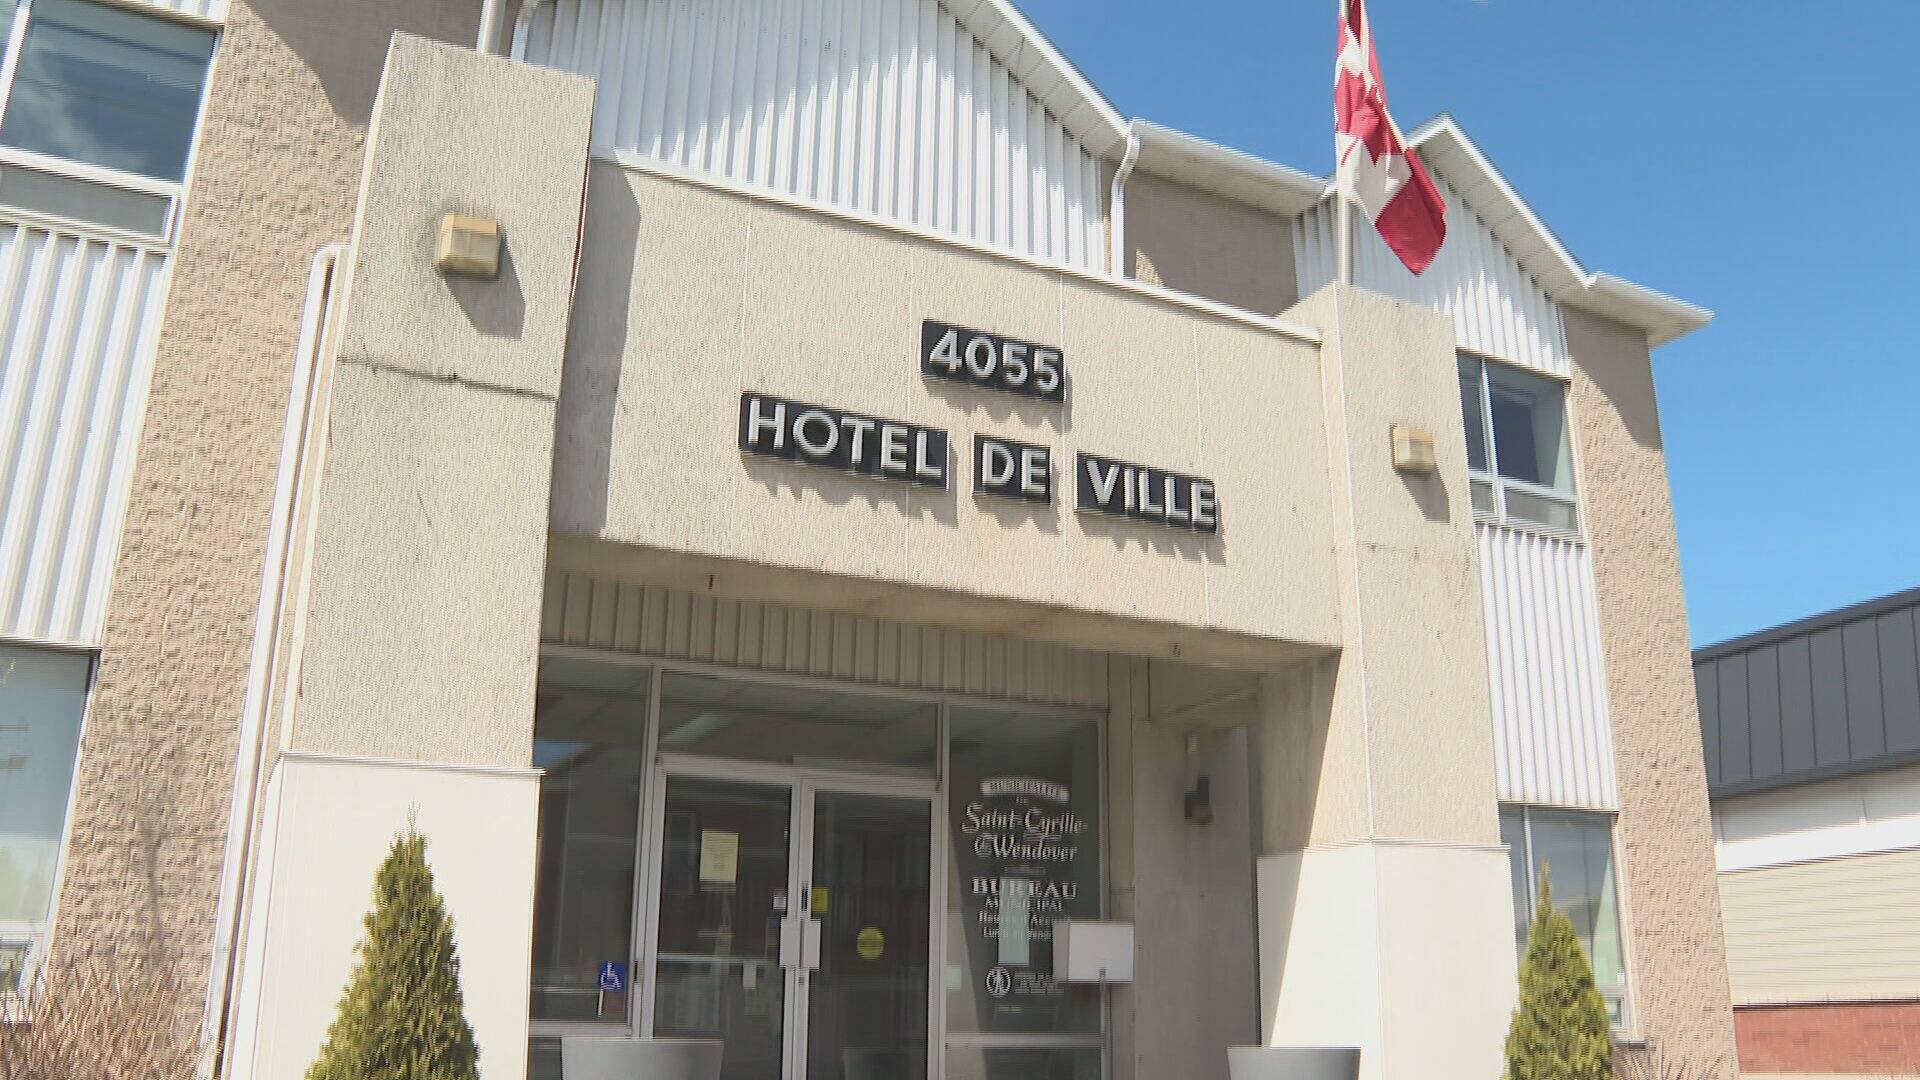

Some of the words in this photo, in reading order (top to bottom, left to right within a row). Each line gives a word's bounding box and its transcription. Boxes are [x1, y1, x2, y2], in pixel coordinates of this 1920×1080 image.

[928, 328, 1060, 394] 4055
[746, 397, 943, 481] HOTEL
[981, 440, 1047, 494] DE
[1086, 458, 1216, 525] VILLE
